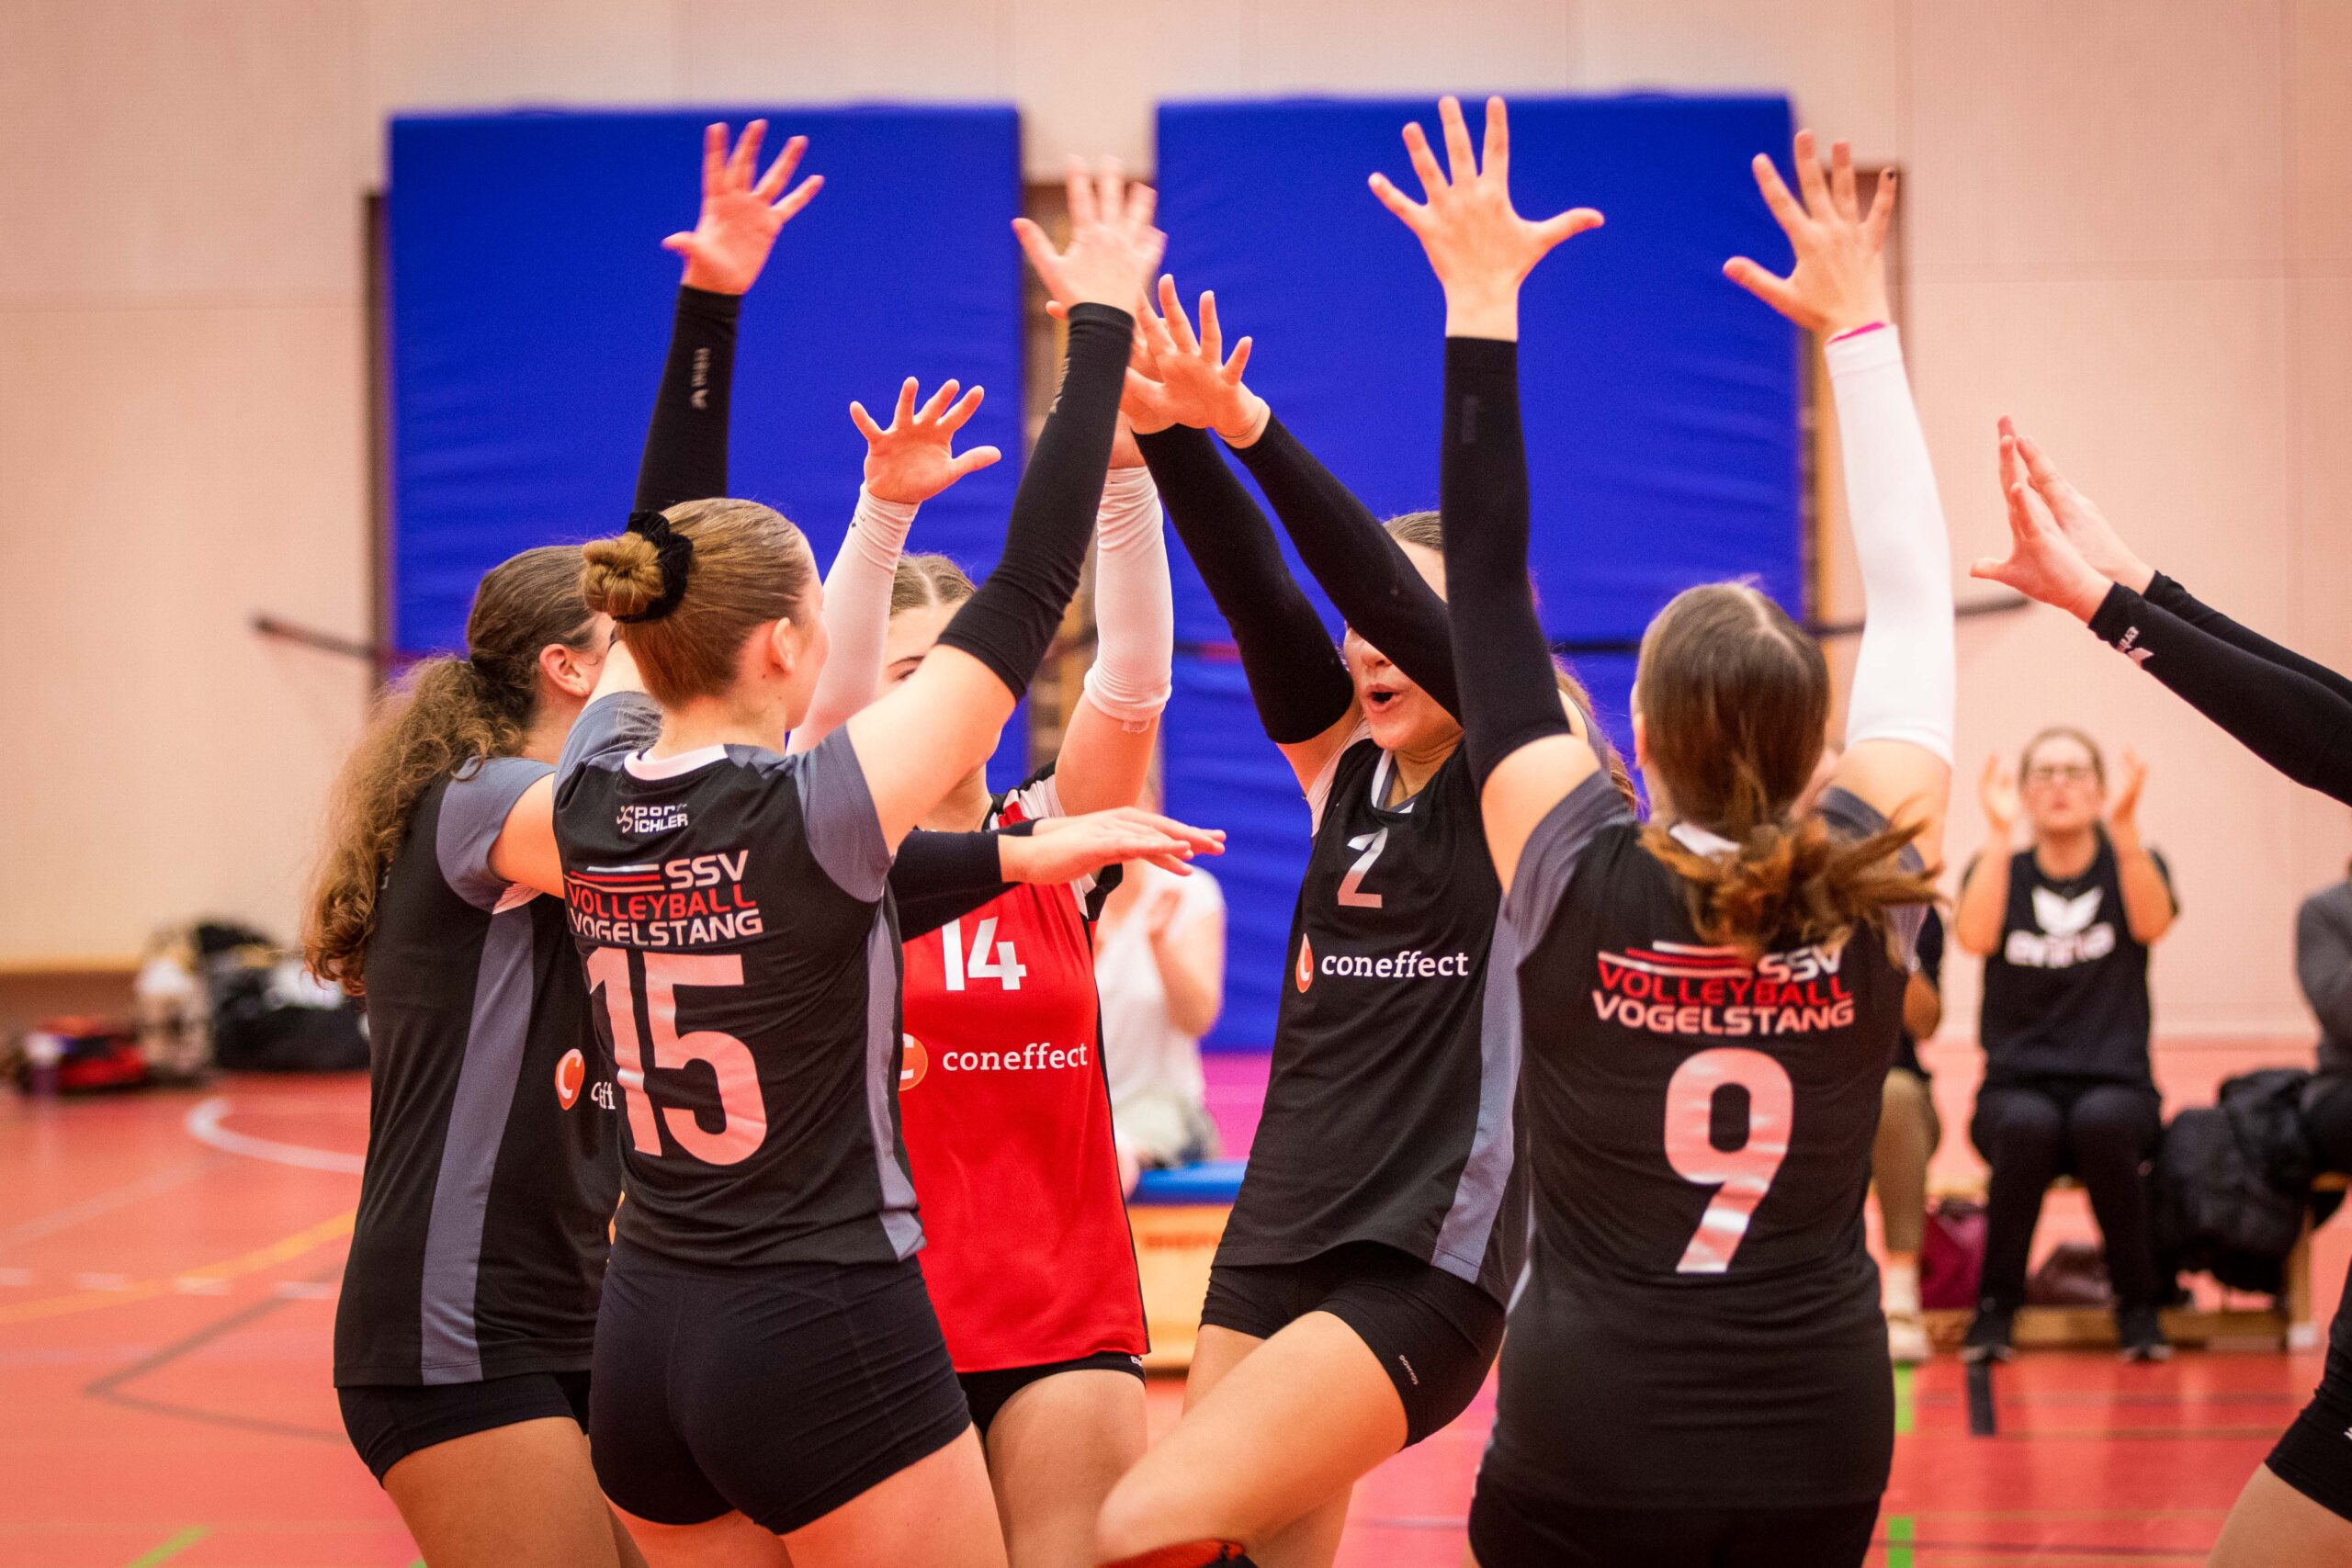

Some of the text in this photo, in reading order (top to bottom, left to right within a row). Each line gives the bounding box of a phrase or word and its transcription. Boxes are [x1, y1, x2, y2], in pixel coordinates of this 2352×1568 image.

[665, 850, 749, 889] SSV
[1337, 827, 1389, 908] 2
[567, 881, 757, 921] VOLLEYBALL
[569, 908, 763, 947] VOGELSTANG
[942, 917, 1027, 991] 14
[1320, 950, 1469, 978] coneffect
[1757, 945, 1843, 985] SSV
[1597, 960, 1853, 1007] VOLLEYBALL
[1591, 989, 1855, 1036] VOGELSTANG
[586, 946, 767, 1166] 15
[942, 1042, 1089, 1071] coneffect
[1664, 1047, 1794, 1274] 9
